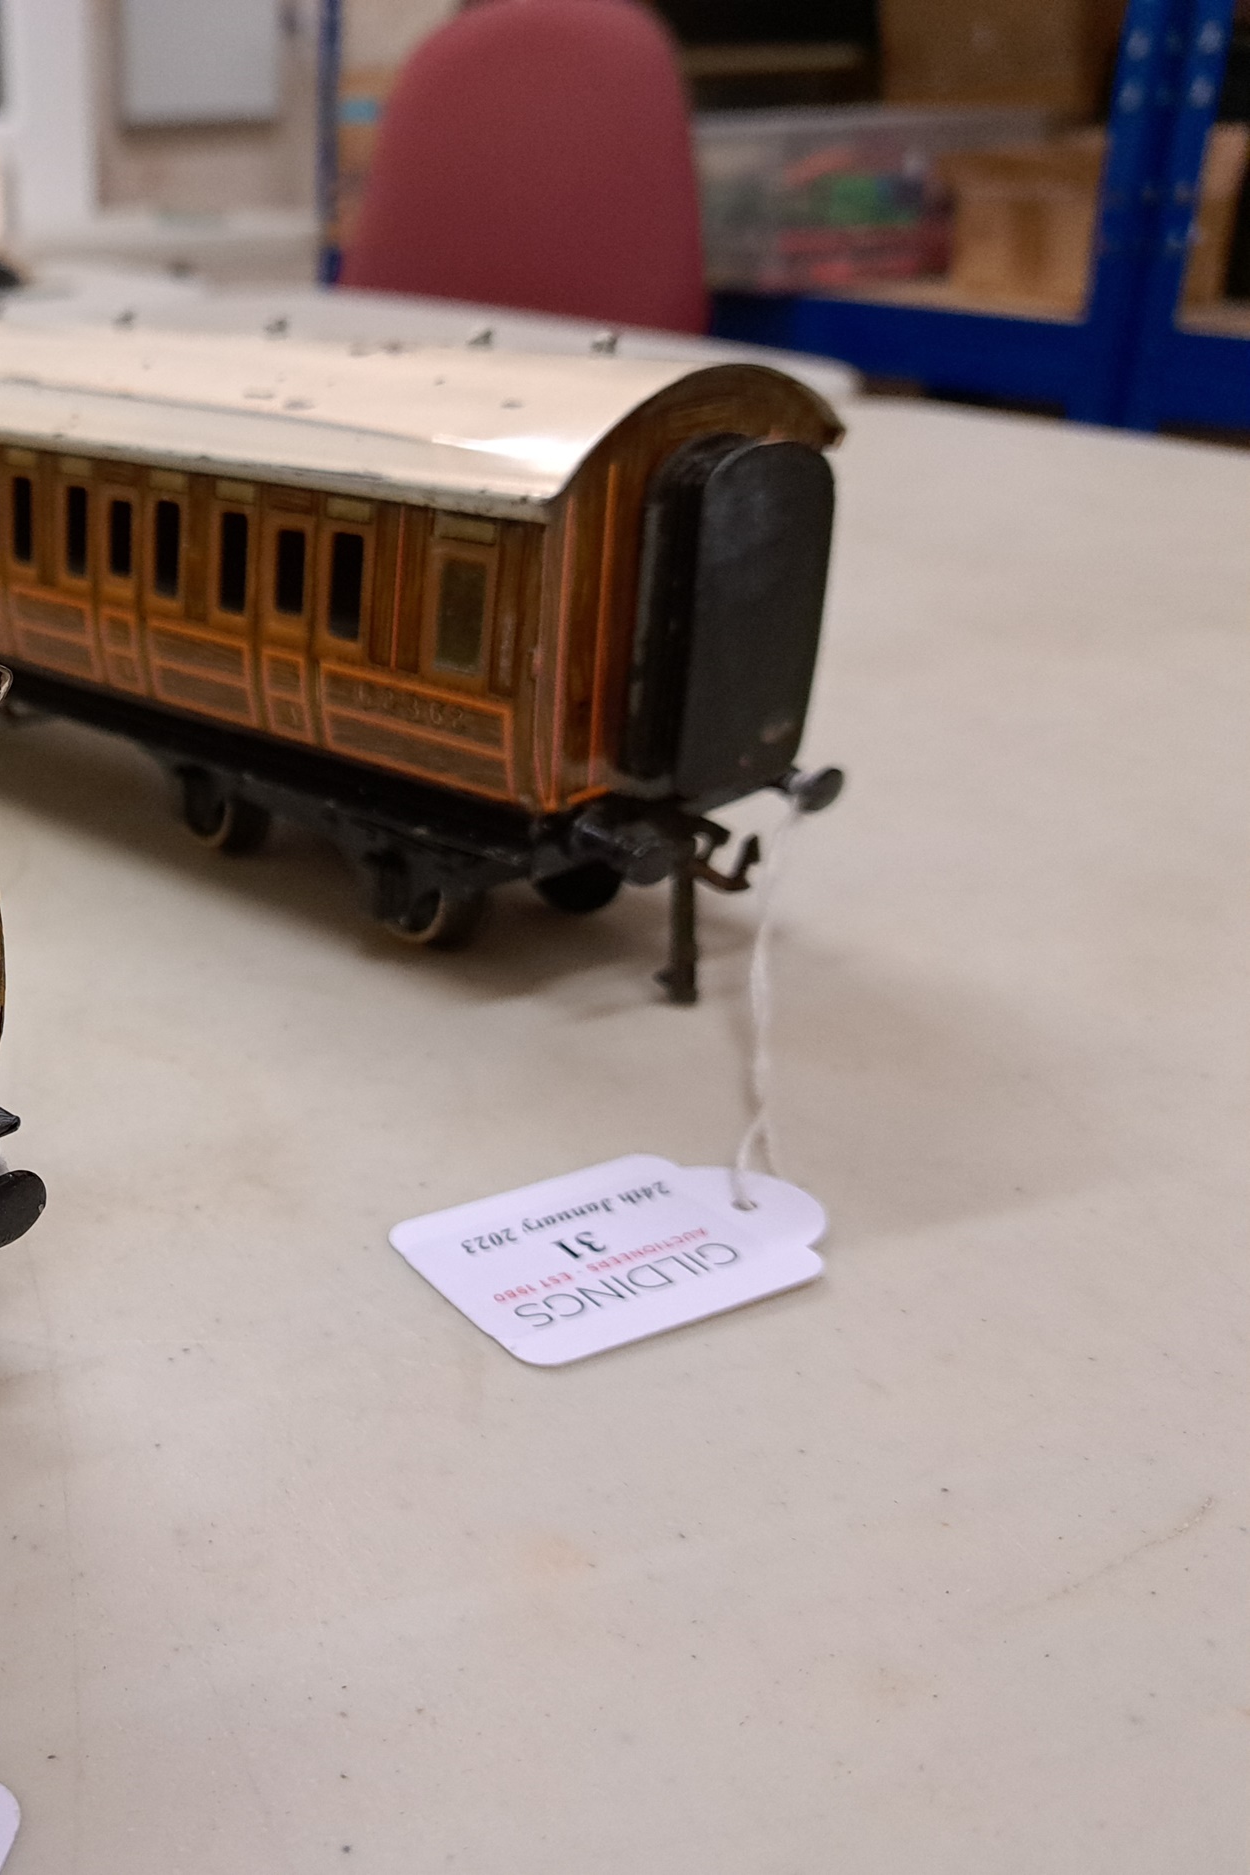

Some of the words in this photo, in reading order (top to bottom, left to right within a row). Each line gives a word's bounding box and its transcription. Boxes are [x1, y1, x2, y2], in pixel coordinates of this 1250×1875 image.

[617, 1181, 671, 1206] 24th
[521, 1198, 617, 1233] January
[461, 1227, 518, 1254] 2023
[552, 1231, 607, 1259] 31
[586, 1227, 708, 1273] AUCTIONEERS
[493, 1284, 537, 1303] 1980
[514, 1243, 738, 1327] GILDINGS
[539, 1271, 574, 1290] EST
